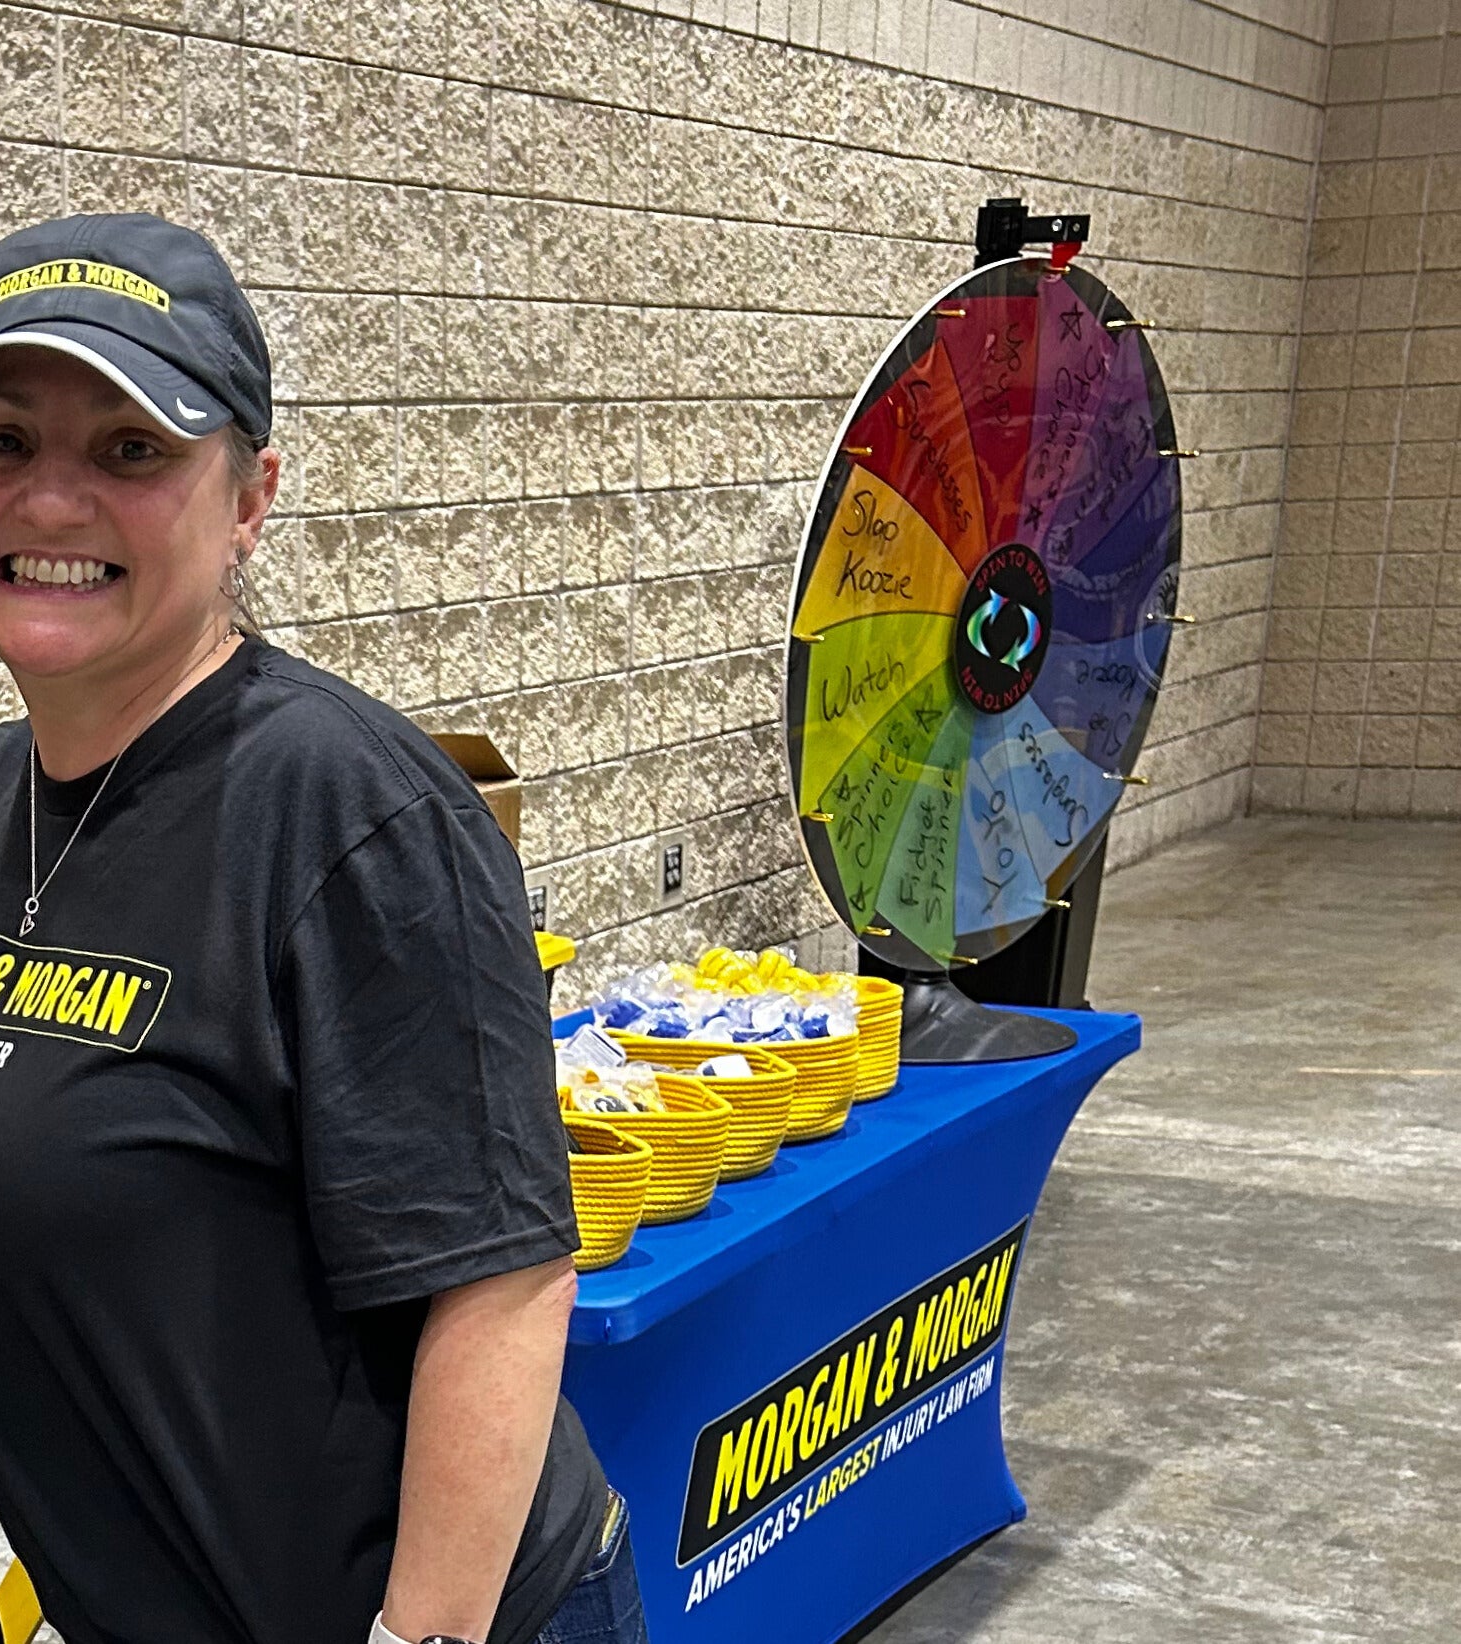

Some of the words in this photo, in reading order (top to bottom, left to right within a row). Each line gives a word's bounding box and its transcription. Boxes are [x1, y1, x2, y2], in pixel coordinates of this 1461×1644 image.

[66, 263, 81, 281] &
[86, 264, 159, 304] MORGAN
[842, 490, 899, 553] Slap
[836, 550, 913, 600] Koozie
[975, 553, 1007, 592] SPIN
[1008, 549, 1026, 568] TO
[821, 653, 908, 723] Watch
[983, 694, 1001, 712] TO
[2, 959, 142, 1036] MORGAN
[706, 1332, 878, 1530] MORGAN
[874, 1315, 905, 1408] &
[902, 1245, 1015, 1390] MORGAN
[684, 1494, 803, 1613] AMERICA'S
[803, 1434, 882, 1520] LARGEST
[881, 1399, 939, 1462] INJURY
[936, 1381, 969, 1422] LAW
[965, 1356, 995, 1404] FIRM
